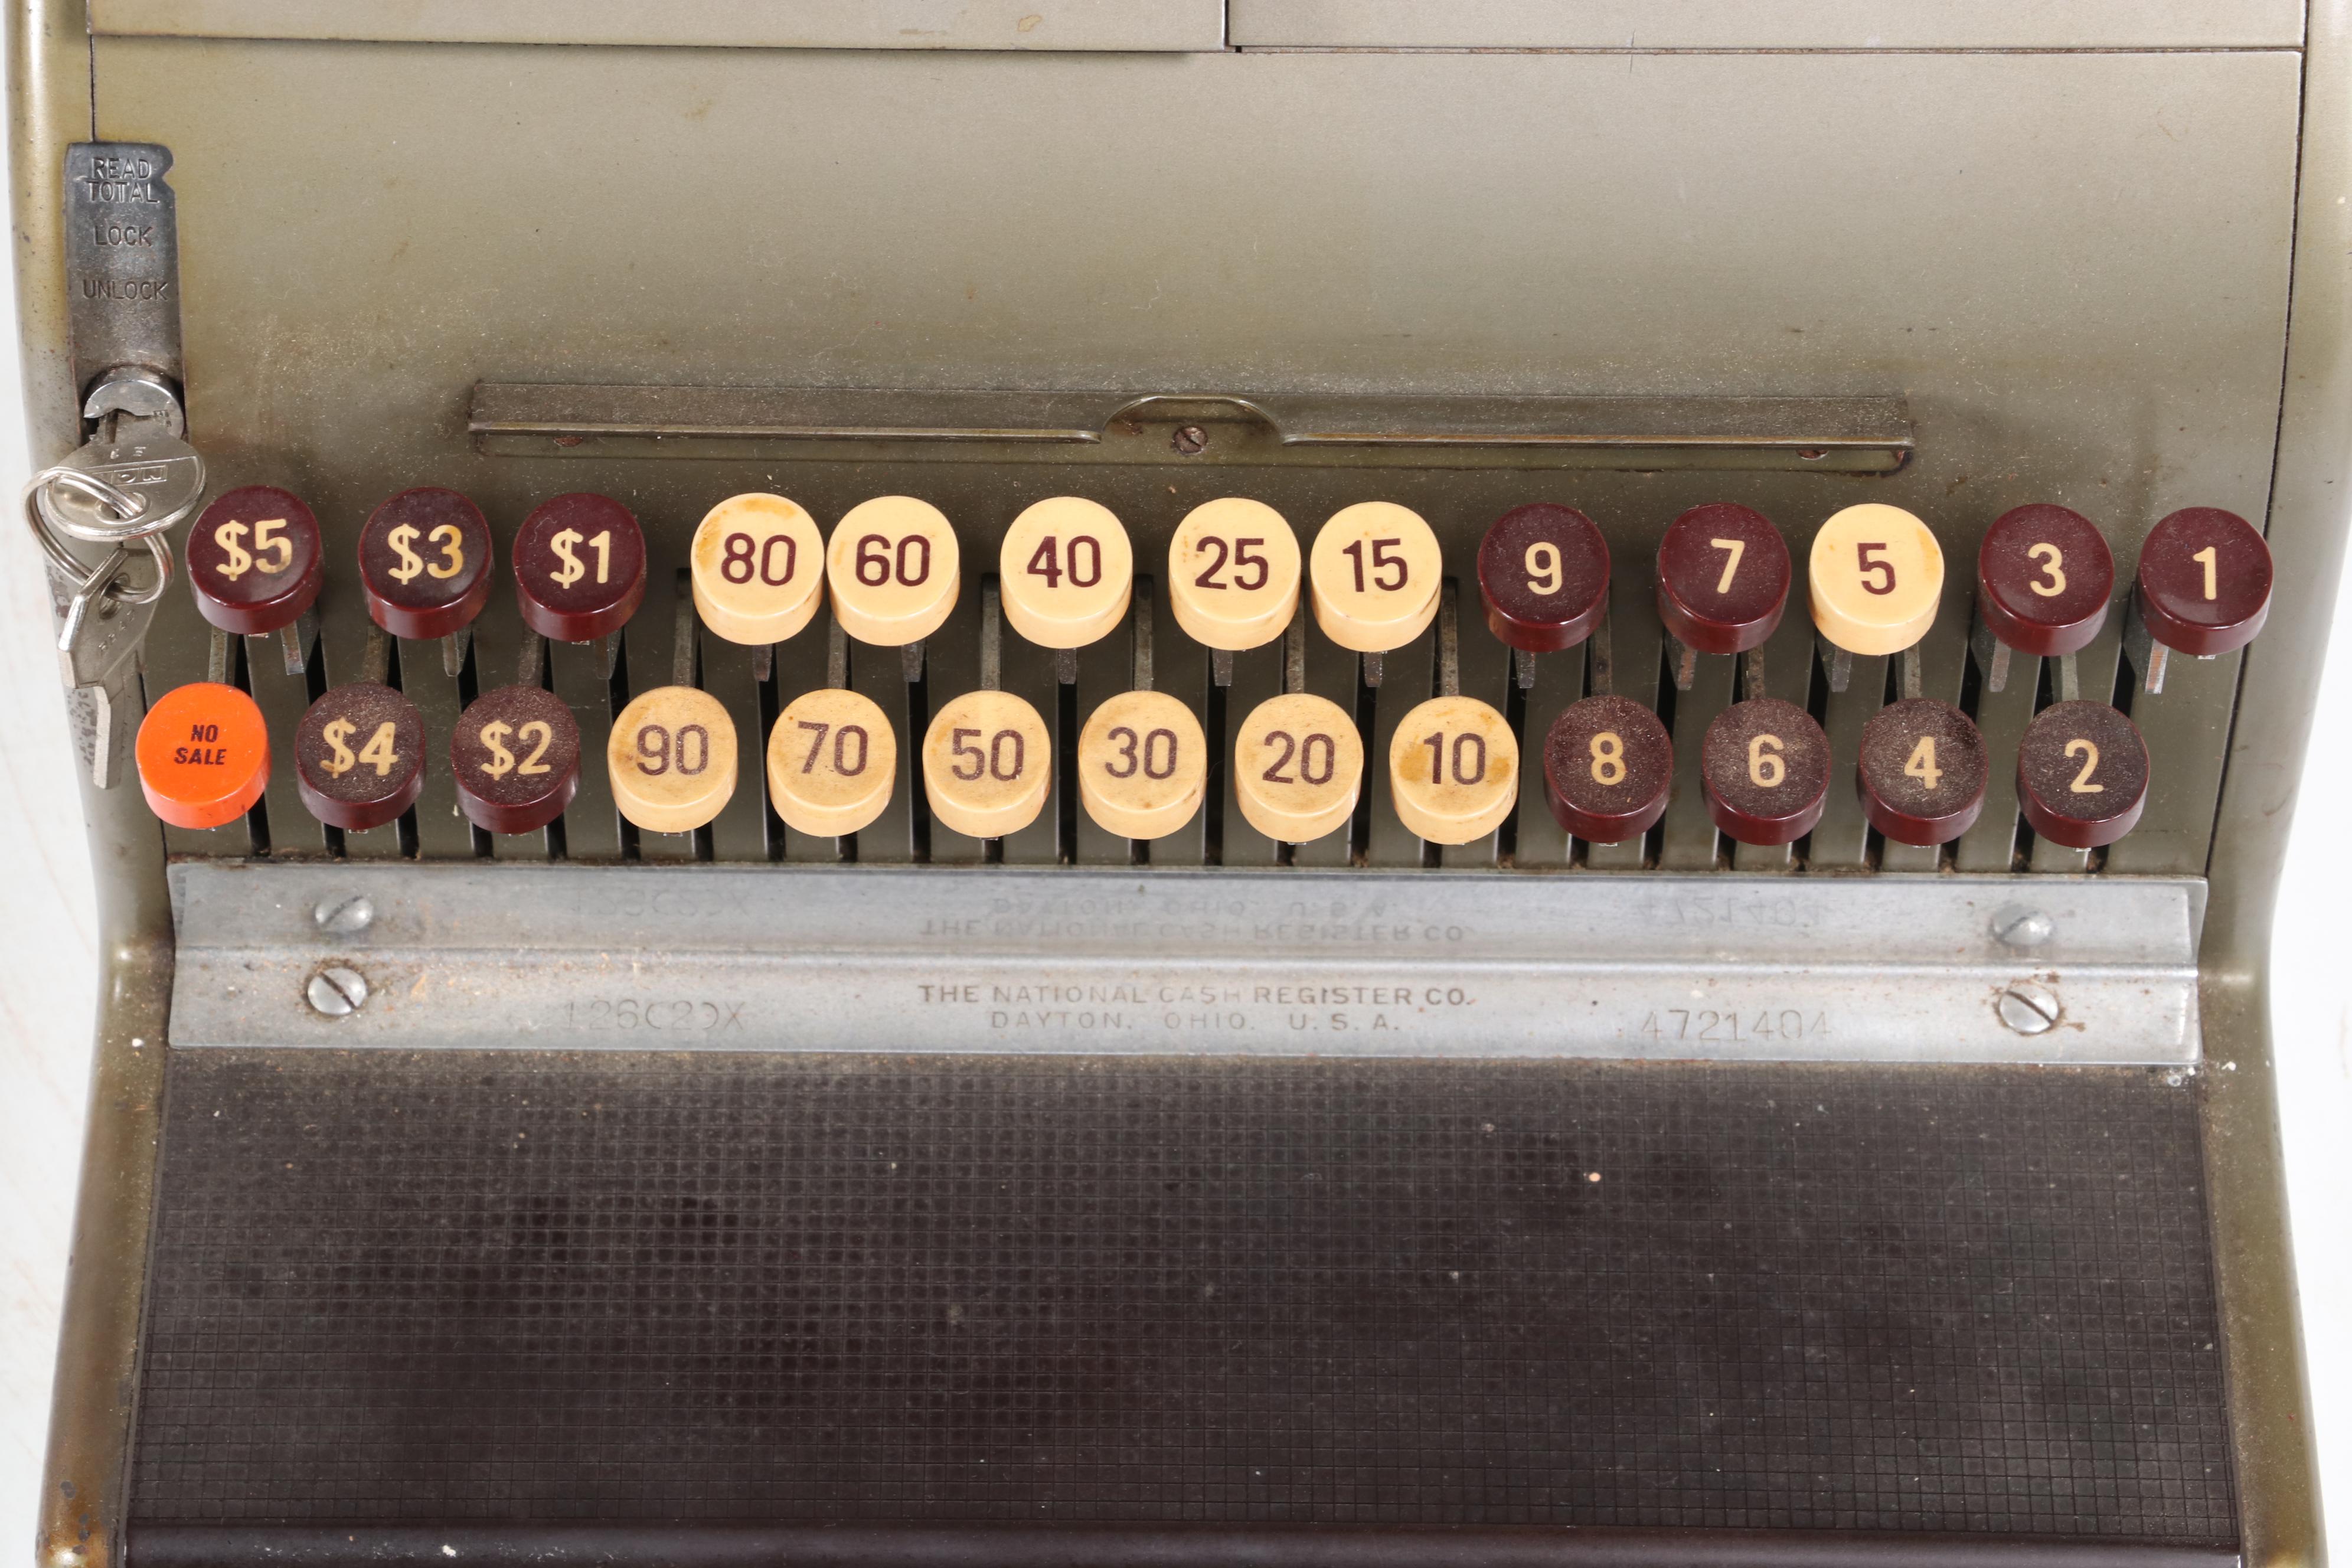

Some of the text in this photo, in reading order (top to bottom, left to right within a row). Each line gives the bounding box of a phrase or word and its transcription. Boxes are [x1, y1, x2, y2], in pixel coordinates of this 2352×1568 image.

[86, 180, 161, 204] TOTAL
[92, 156, 152, 179] READ
[94, 226, 153, 247] LOCK
[82, 279, 168, 301] UNLOCK
[214, 518, 292, 581] $5
[387, 522, 464, 585] $3
[550, 527, 611, 589] $1
[721, 532, 796, 586] 80
[855, 534, 930, 587] 60
[1027, 535, 1102, 588] 40
[1194, 536, 1269, 591] 25
[1342, 538, 1409, 592] 15
[1525, 541, 1562, 596] 9
[1710, 538, 1746, 594] 7
[1857, 542, 1897, 596] 5
[2027, 543, 2067, 597] 3
[2193, 545, 2217, 601] 1
[174, 747, 227, 765] SALE
[190, 724, 218, 743] NO
[320, 716, 398, 780] $4
[479, 720, 553, 781] $2
[636, 724, 708, 776] 90
[798, 720, 868, 777] 70
[951, 728, 1024, 781] 50
[1105, 726, 1177, 780] 30
[1262, 730, 1335, 785] 20
[1423, 731, 1487, 786] 10
[1589, 731, 1625, 786] 8
[1747, 734, 1786, 788] 6
[1903, 736, 1943, 790] 4
[2064, 739, 2105, 794] 2
[918, 985, 980, 1004] THE
[992, 985, 1148, 1004] NATIONAL
[1159, 986, 1240, 1005] CASH
[1254, 987, 1412, 1005] REGISTER
[1640, 1009, 1832, 1041] 4721404
